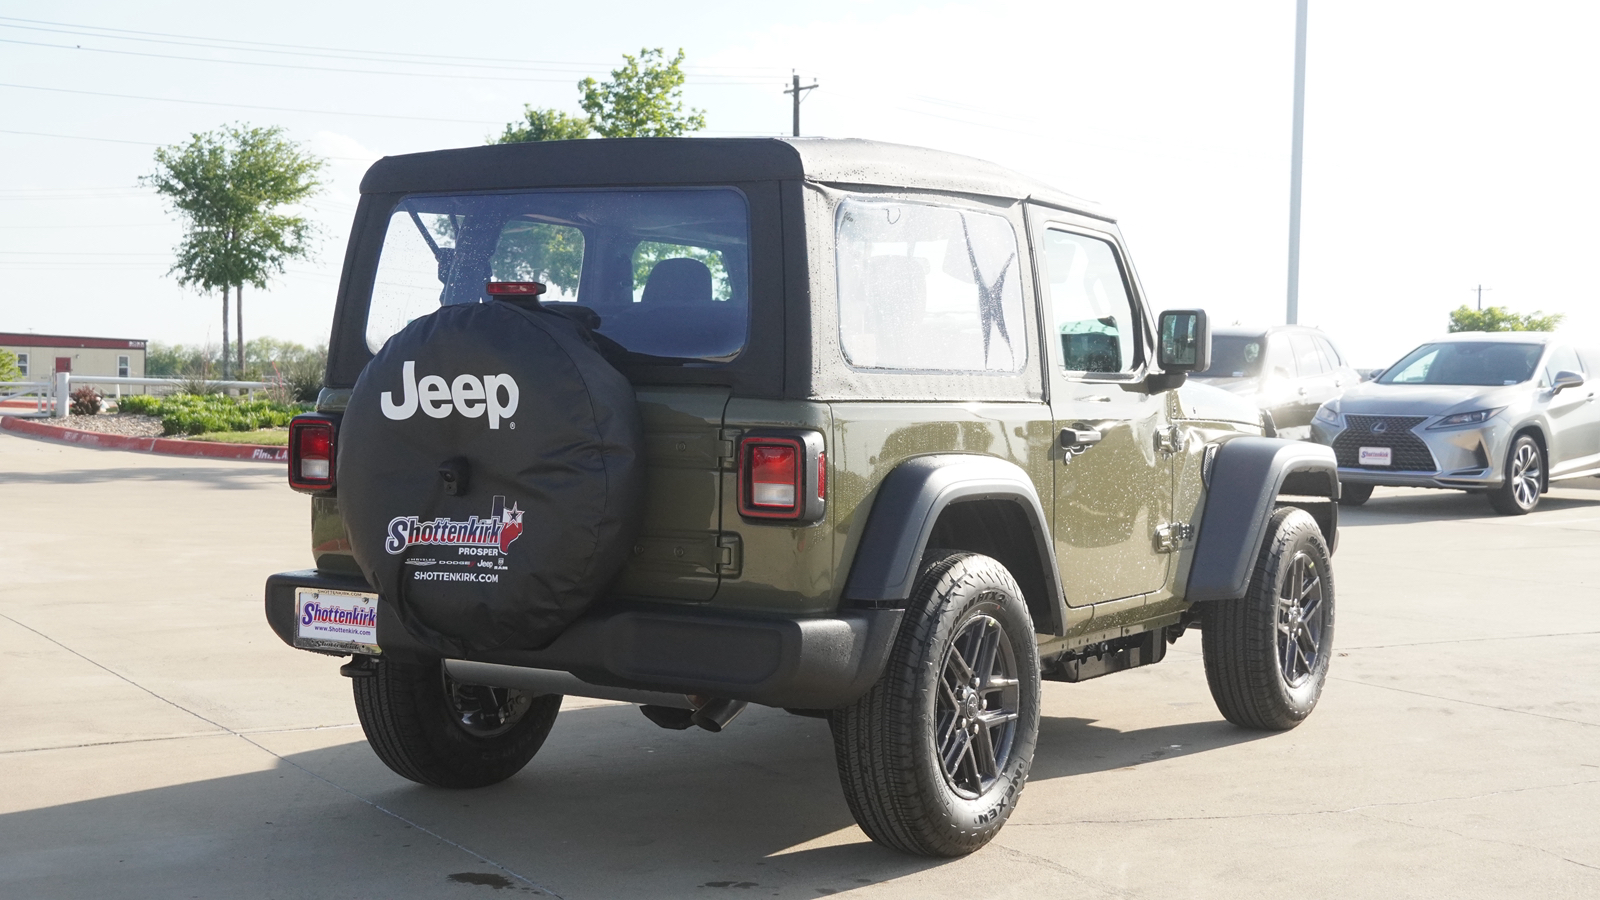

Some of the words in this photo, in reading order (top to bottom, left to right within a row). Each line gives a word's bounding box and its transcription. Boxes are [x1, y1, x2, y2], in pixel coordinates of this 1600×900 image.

[380, 360, 519, 429] Jeep
[386, 516, 503, 554] Shottenkirk
[458, 547, 498, 556] PROSPER
[477, 559, 493, 569] Jeep
[413, 571, 499, 583] SHOTTENKIRK.COM
[302, 602, 377, 626] Shottenkirk
[314, 625, 371, 636] www.Shottenkirk.com
